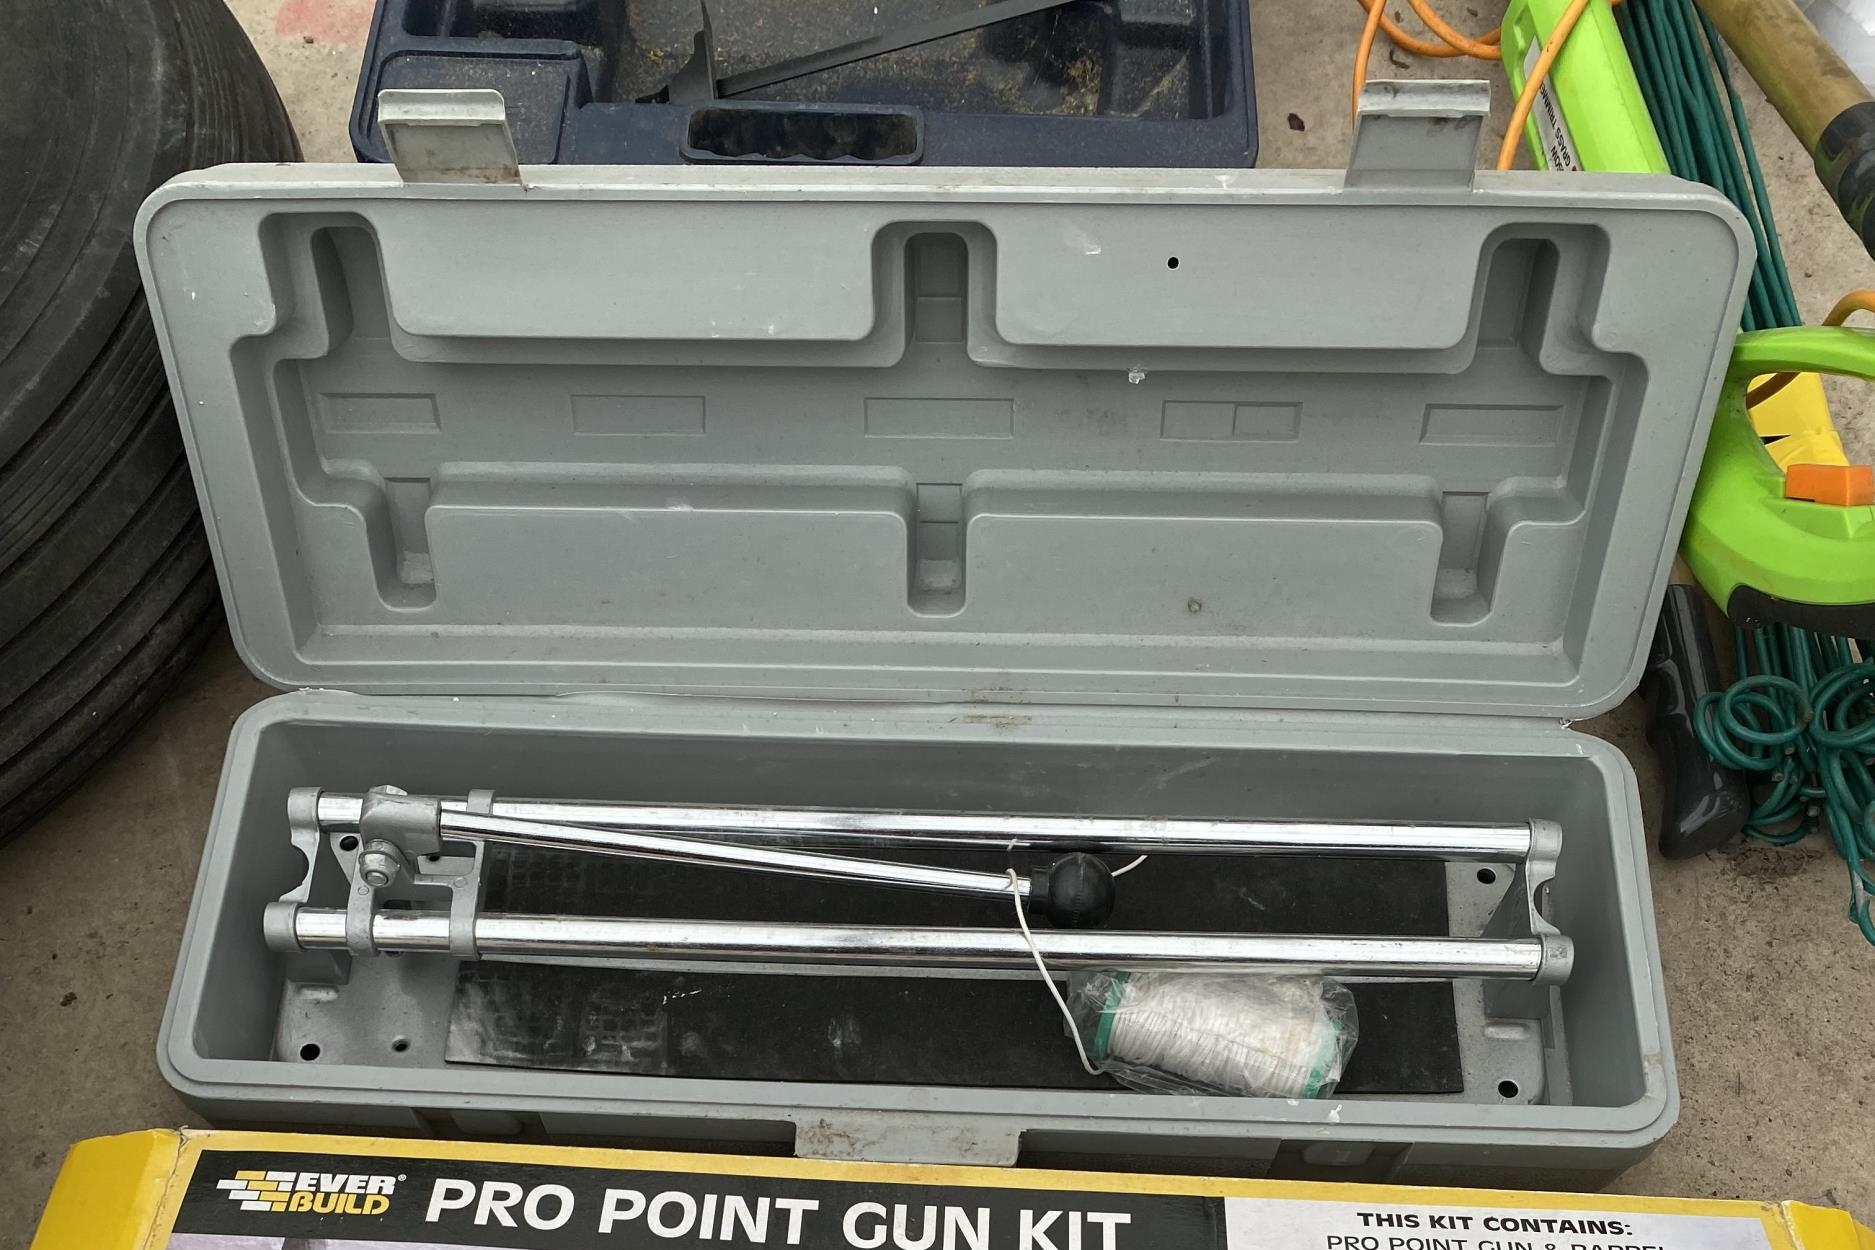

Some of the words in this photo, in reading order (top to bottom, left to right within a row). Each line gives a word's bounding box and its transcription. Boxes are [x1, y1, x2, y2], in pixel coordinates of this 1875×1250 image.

[1540, 81, 1557, 130] TRIMME
[1555, 128, 1571, 166] GRASS
[300, 1172, 396, 1195] EVER
[289, 1193, 390, 1215] BUILD
[425, 1178, 575, 1229] PRO
[598, 1188, 819, 1245] POINT
[1357, 1212, 1420, 1228] THIS
[1428, 1215, 1473, 1230] KIT
[1482, 1216, 1633, 1235] CONTAINS:
[1326, 1235, 1379, 1250] PRO
